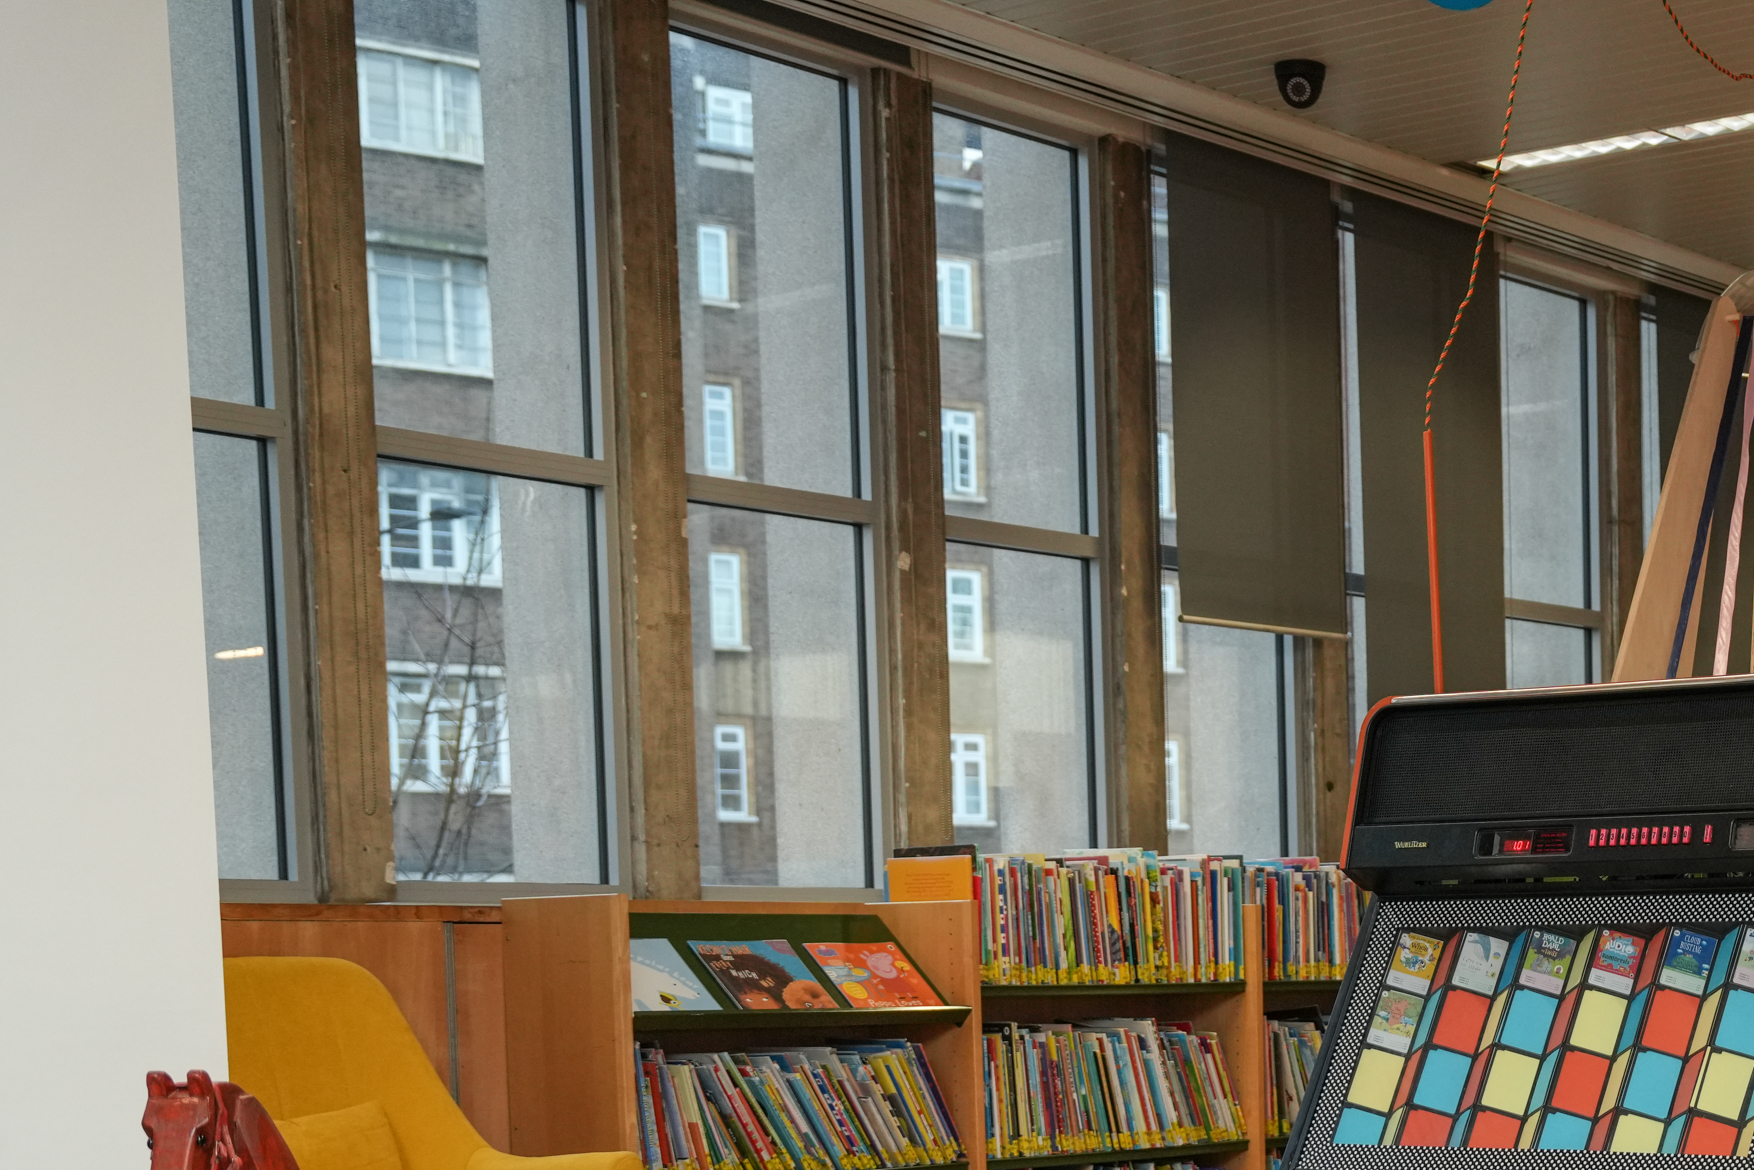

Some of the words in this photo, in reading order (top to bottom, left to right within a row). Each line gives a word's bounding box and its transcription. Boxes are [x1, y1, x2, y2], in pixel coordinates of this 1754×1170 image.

[1394, 841, 1427, 849] WURLITZER
[1542, 934, 1565, 944] ROALD
[1684, 935, 1702, 945] CLOUD
[730, 944, 752, 955] HAIR
[1542, 941, 1560, 951] DAHL
[1605, 940, 1634, 954] AUDIO
[1680, 941, 1702, 954] BUSTING
[710, 960, 733, 971] EVERY
[673, 972, 698, 988] bear
[729, 969, 759, 980] WHICH
[759, 976, 776, 988] WAY
[868, 999, 895, 1008] Peppa
